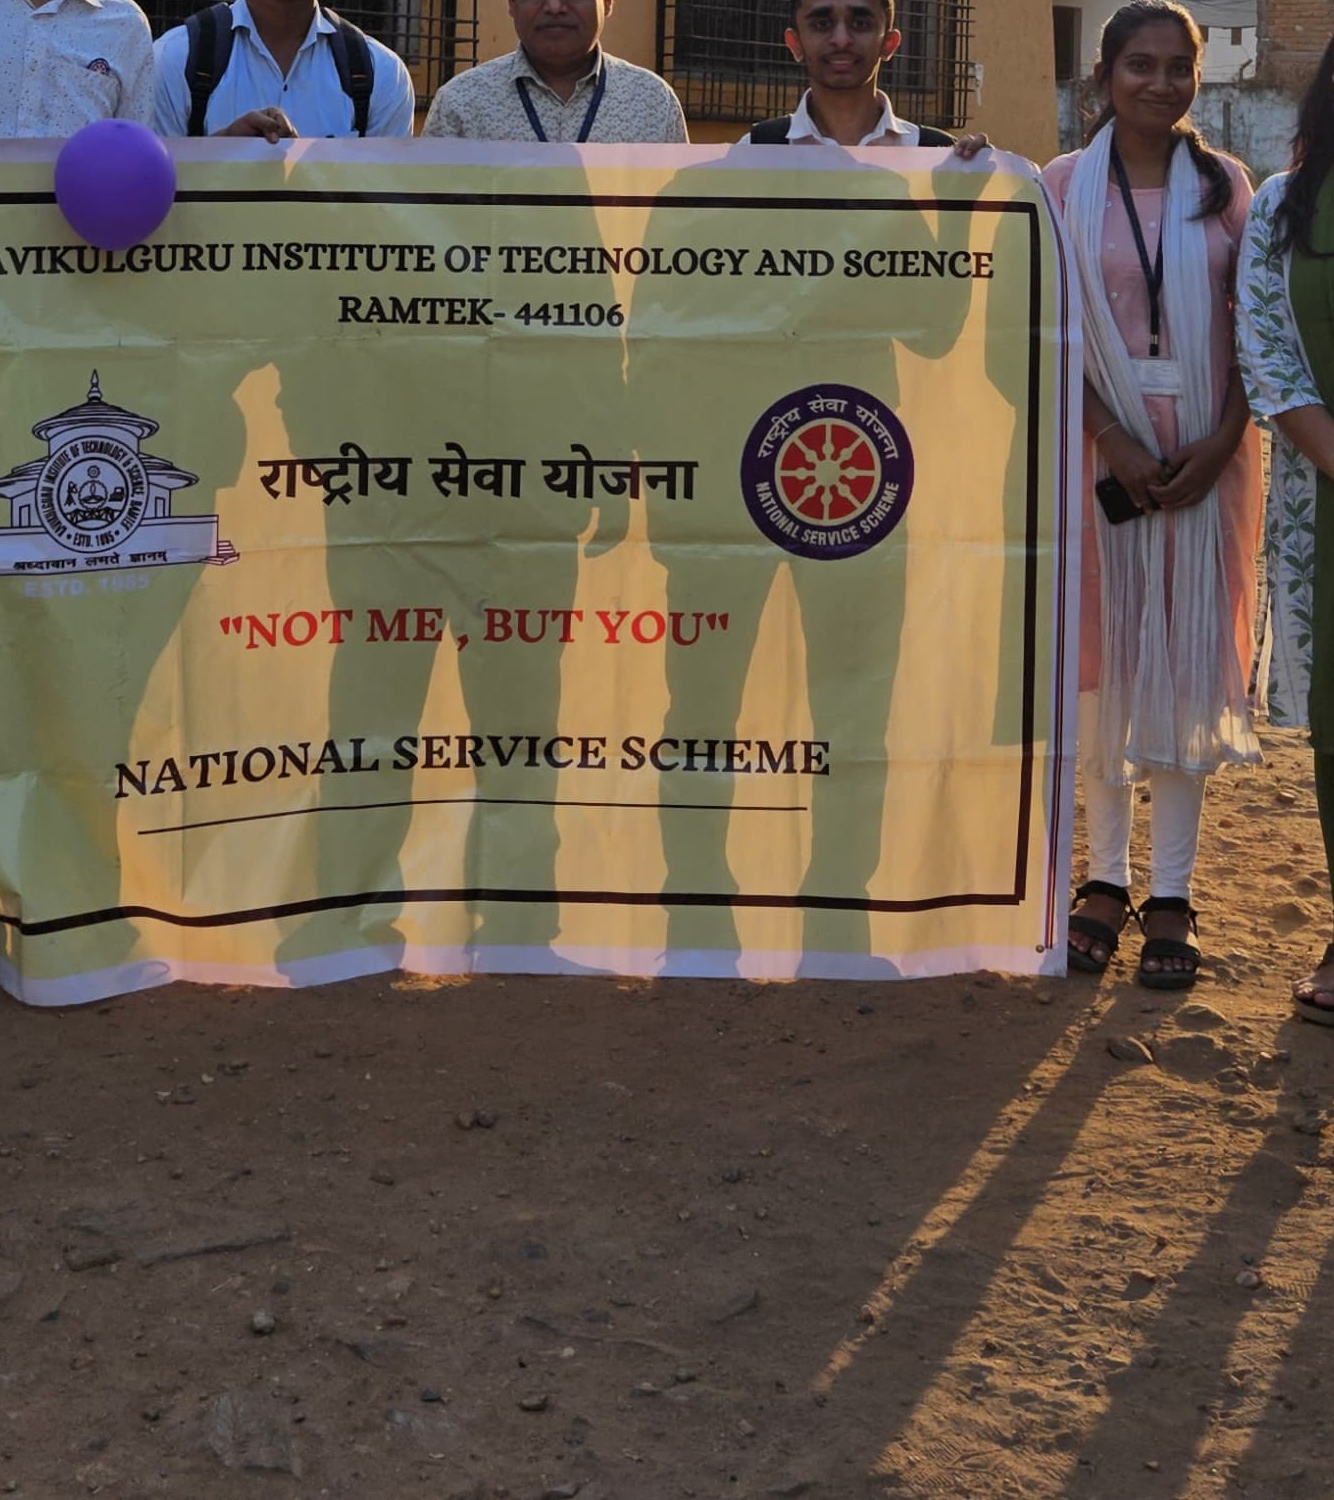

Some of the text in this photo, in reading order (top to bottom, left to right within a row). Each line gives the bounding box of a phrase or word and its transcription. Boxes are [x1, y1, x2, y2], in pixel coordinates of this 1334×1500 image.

[241, 242, 435, 272] INSTITUTE
[444, 245, 492, 273] OF
[499, 246, 749, 276] TECHNOLOGY
[754, 249, 835, 277] AND
[843, 249, 995, 278] SCIENCE
[338, 296, 625, 327] RAMTEK- 441106
[758, 394, 899, 459] राष्ट्रीय सेवा योजना
[258, 442, 699, 505] राष्ट्रीय सेवा योजना
[755, 481, 900, 546] NATIONAL SERVICE SCHEME
[220, 609, 353, 650] "NOT
[483, 608, 583, 643] BUT
[595, 610, 729, 646] YOU"
[114, 734, 830, 798] NATIONAL SERVICE SCHEME
